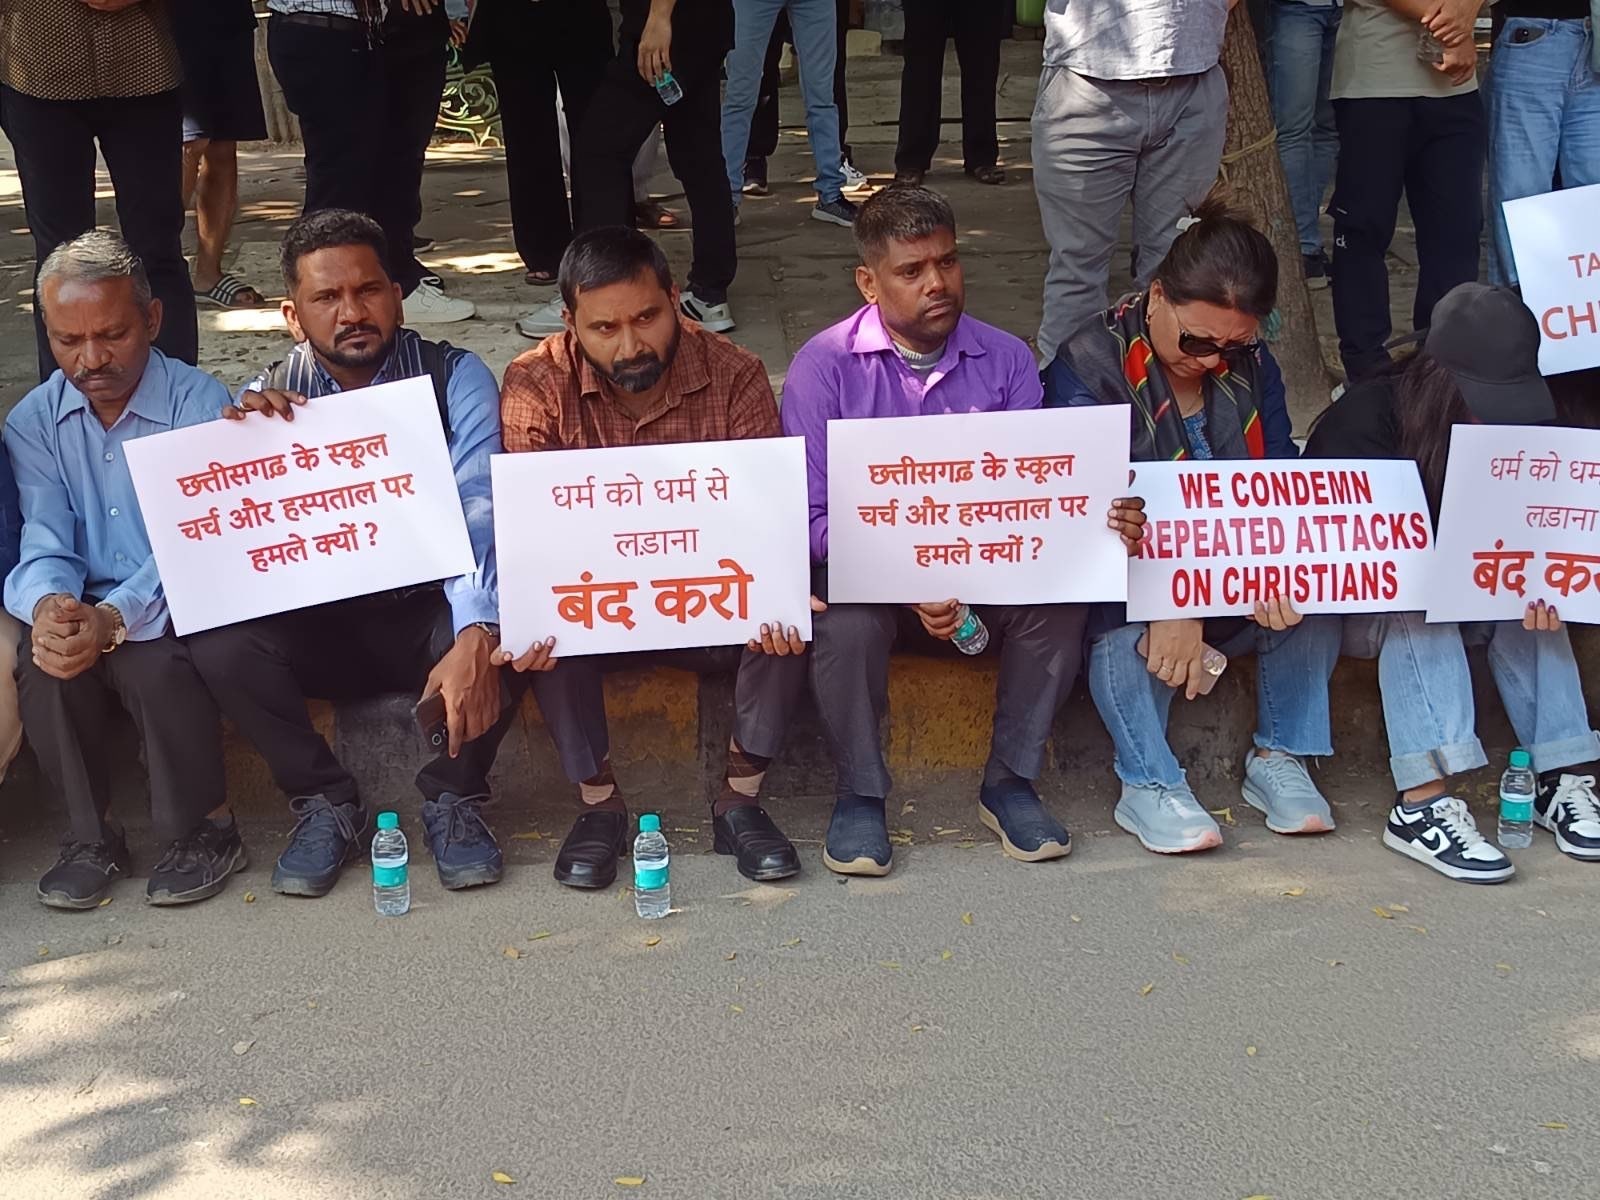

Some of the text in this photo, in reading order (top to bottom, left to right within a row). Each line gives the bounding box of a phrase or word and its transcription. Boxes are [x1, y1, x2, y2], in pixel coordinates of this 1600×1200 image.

[1541, 299, 1600, 340] CH
[176, 433, 389, 498] छत्तीसगढ़ के स्कूल
[867, 451, 1077, 486] छत्तीसगढ़ के स्कूल
[1490, 450, 1526, 481] धर्म
[1529, 450, 1562, 482] को
[177, 473, 415, 541] चर्च और हस्पताल पर
[551, 467, 730, 510] धर्म को धर्म से
[1178, 470, 1374, 510] WE CONDEMN
[857, 495, 1090, 527] चर्च और हस्पताल पर
[1526, 505, 1599, 532] लड़ाना
[246, 532, 309, 573] हमले
[311, 522, 360, 556] क्यों
[613, 528, 700, 557] लड़ाना
[913, 536, 974, 568] हमले
[977, 533, 1025, 565] क्यों
[1137, 511, 1429, 561] REPEATED ATTACKS
[1171, 560, 1399, 609] ON CHRISTIANS
[1472, 538, 1535, 598] बंद
[551, 558, 755, 631] बंद करो
